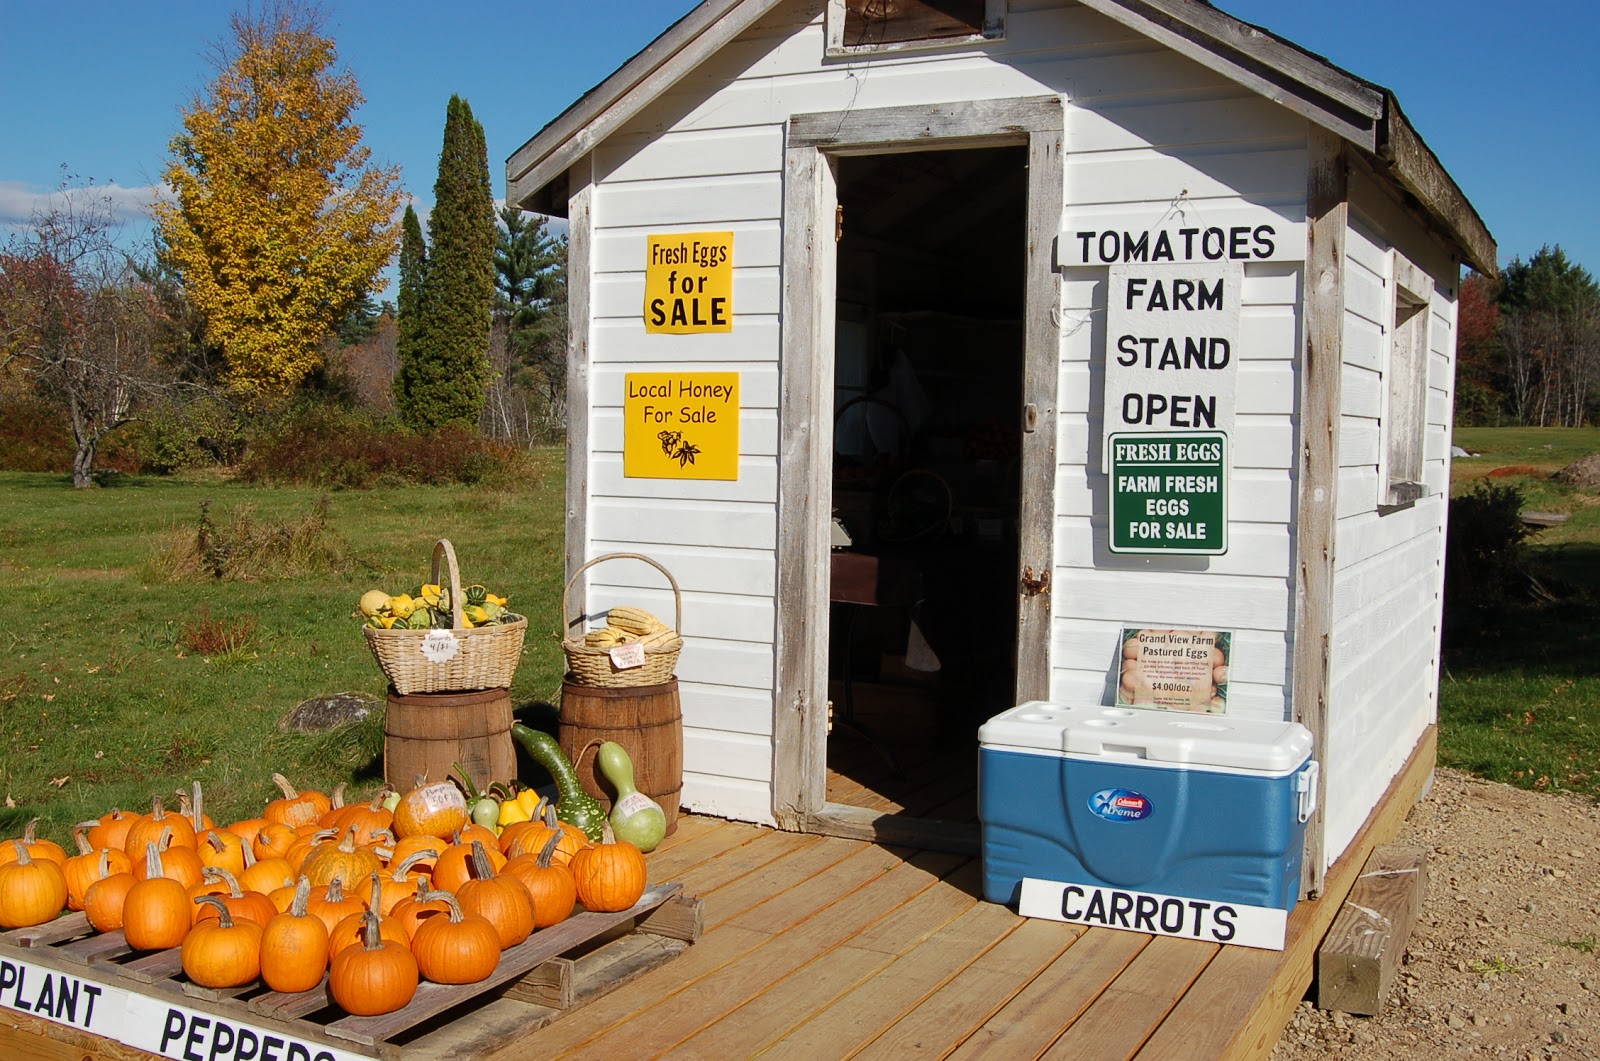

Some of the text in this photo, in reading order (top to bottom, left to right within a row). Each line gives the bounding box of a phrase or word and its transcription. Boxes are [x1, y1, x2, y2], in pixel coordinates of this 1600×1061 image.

[652, 241, 727, 267] Fresh Eggs
[1076, 225, 1276, 263] TOMATOES
[668, 270, 708, 294] for
[1126, 278, 1224, 311] FARM
[650, 297, 727, 326] SALE
[1116, 334, 1231, 370] STAND
[629, 380, 733, 403] Local Honey
[644, 405, 717, 423] For Sale
[1122, 393, 1217, 428] OPEN
[1115, 442, 1221, 461] FRESH EGGS
[1118, 475, 1218, 493] FARM FRESH
[1146, 498, 1190, 516] EGGS
[1129, 521, 1207, 540] FOR SALE
[1139, 633, 1214, 646] Grand View Farm
[1143, 646, 1208, 659] Pastured Eggs
[1152, 682, 1192, 692] $4.00/doz.
[1061, 886, 1238, 941] CARROTS
[0, 960, 337, 1061] PLANT PEPPE
